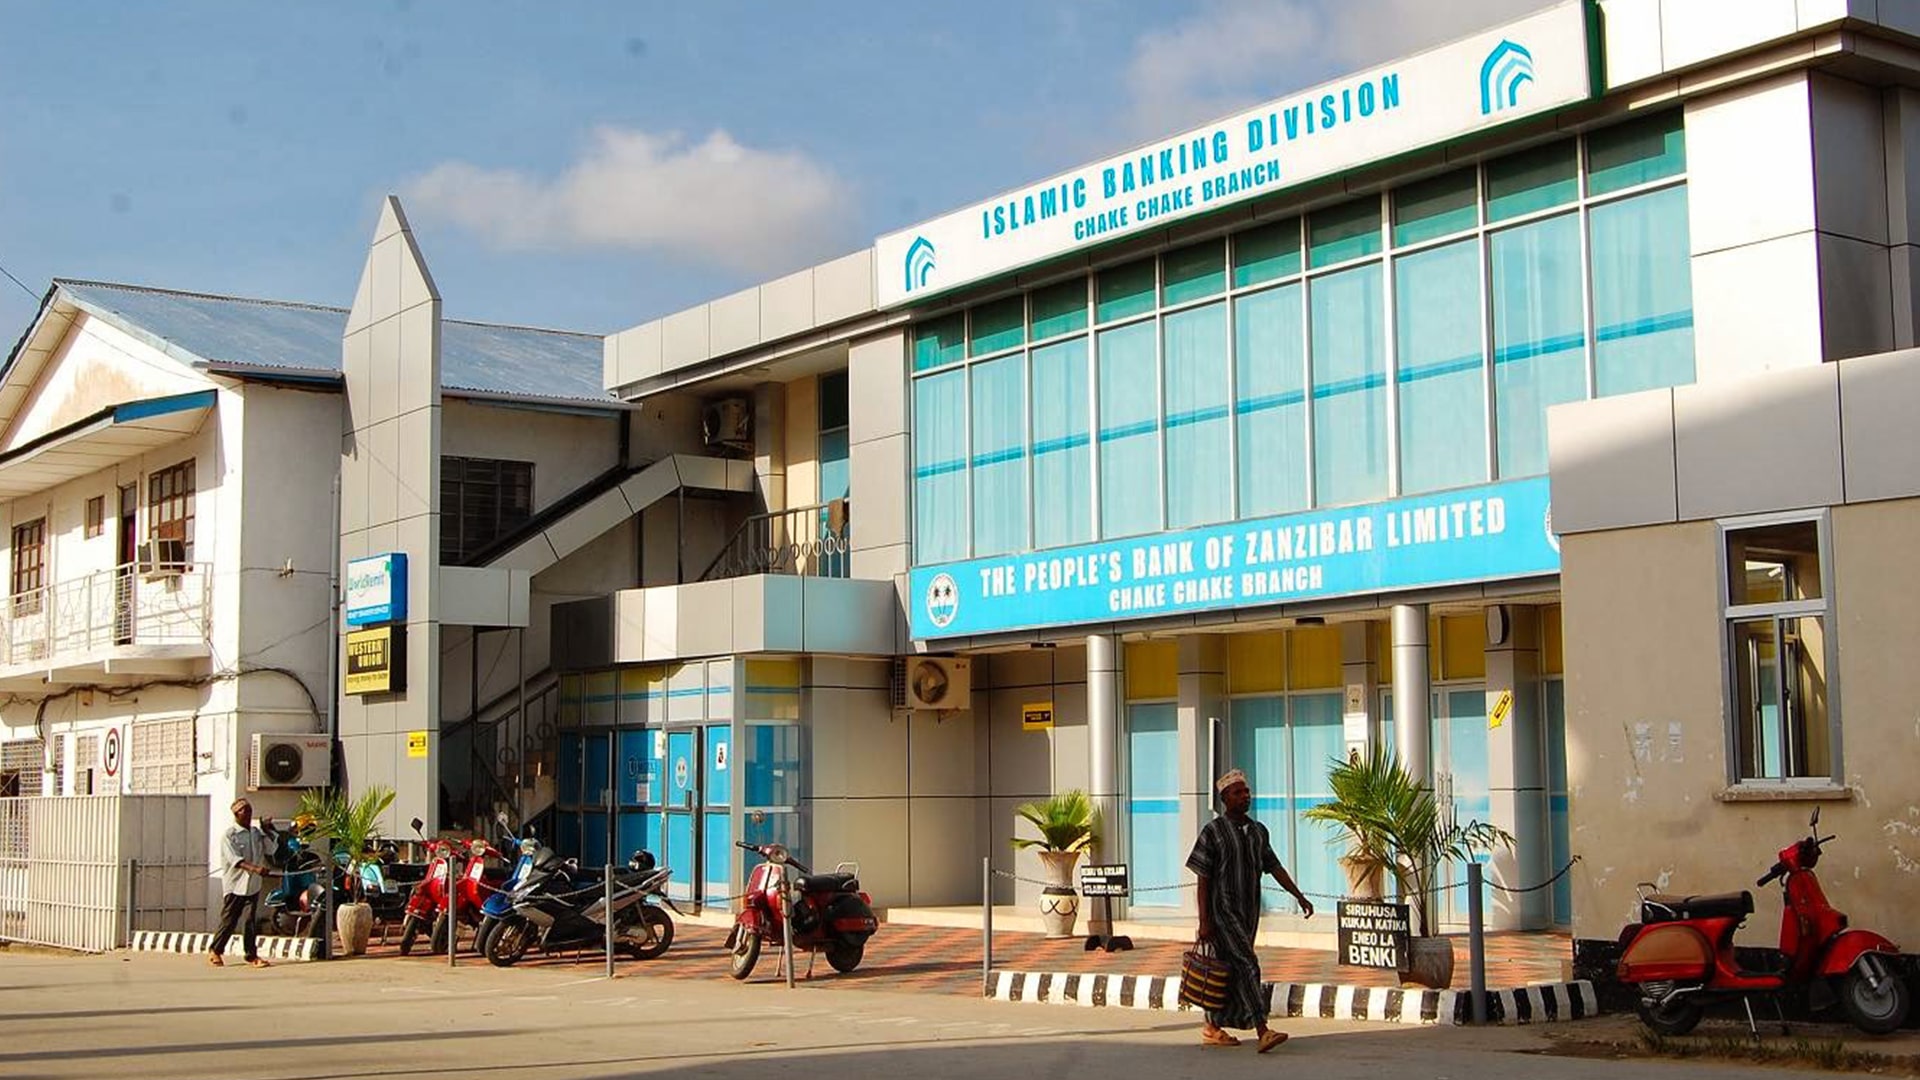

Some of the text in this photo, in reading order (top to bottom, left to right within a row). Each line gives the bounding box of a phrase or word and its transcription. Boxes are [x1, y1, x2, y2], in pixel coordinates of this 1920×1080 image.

[983, 73, 1400, 239] ISLAMIC BANKING DIVISION
[1074, 159, 1280, 241] CHAKE CHAKE BRANCH
[979, 496, 1506, 598] THE PEOPLE'S BANK OF ZANZIBAR LIMITED
[1108, 564, 1323, 612] CHAKE CHAKE BRANCH
[109, 739, 116, 767] P
[1340, 916, 1407, 931] KUKAA KATIKA
[1345, 903, 1397, 918] SIRUHUSA
[1352, 931, 1395, 947] ENEO LA
[1348, 944, 1397, 968] BENKI
